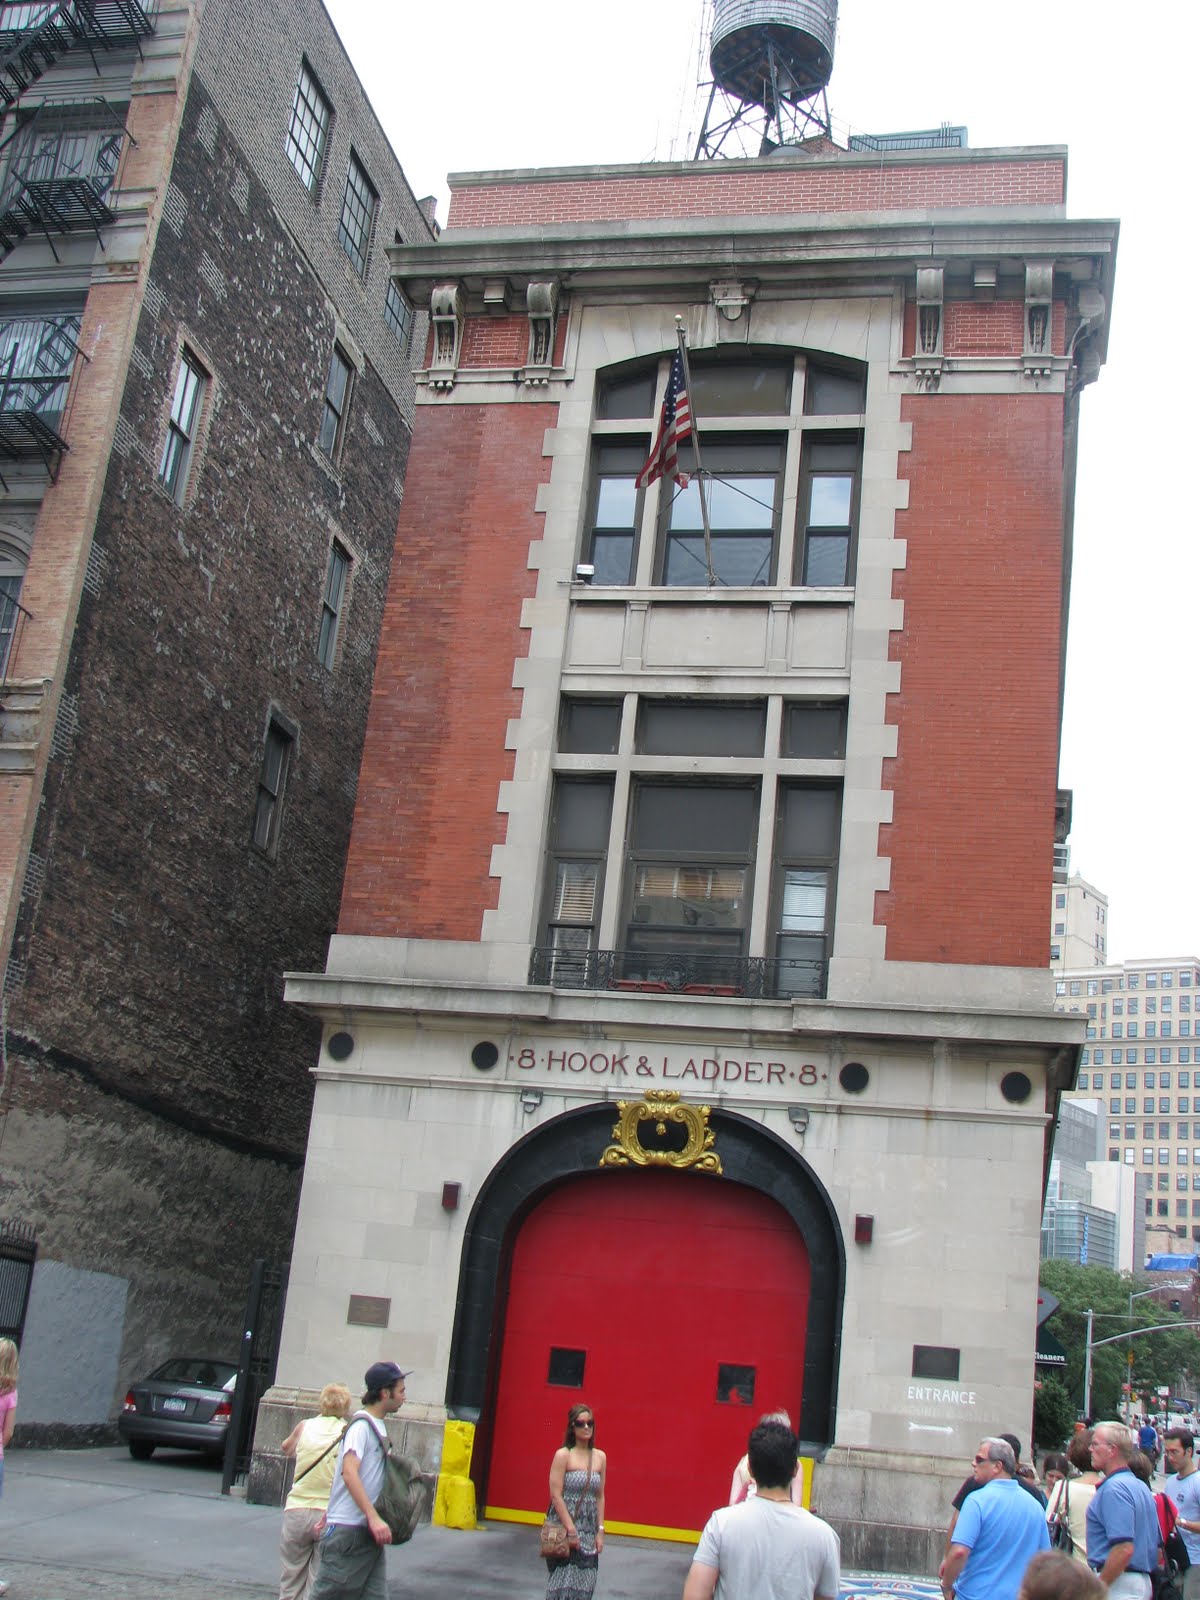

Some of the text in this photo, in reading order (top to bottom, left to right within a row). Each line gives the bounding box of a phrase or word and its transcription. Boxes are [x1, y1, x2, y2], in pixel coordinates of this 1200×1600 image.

[547, 1050, 630, 1076] HOOK
[635, 1055, 655, 1077] &
[662, 1056, 786, 1084] LADDER
[907, 1386, 976, 1405] ENTRANCE
